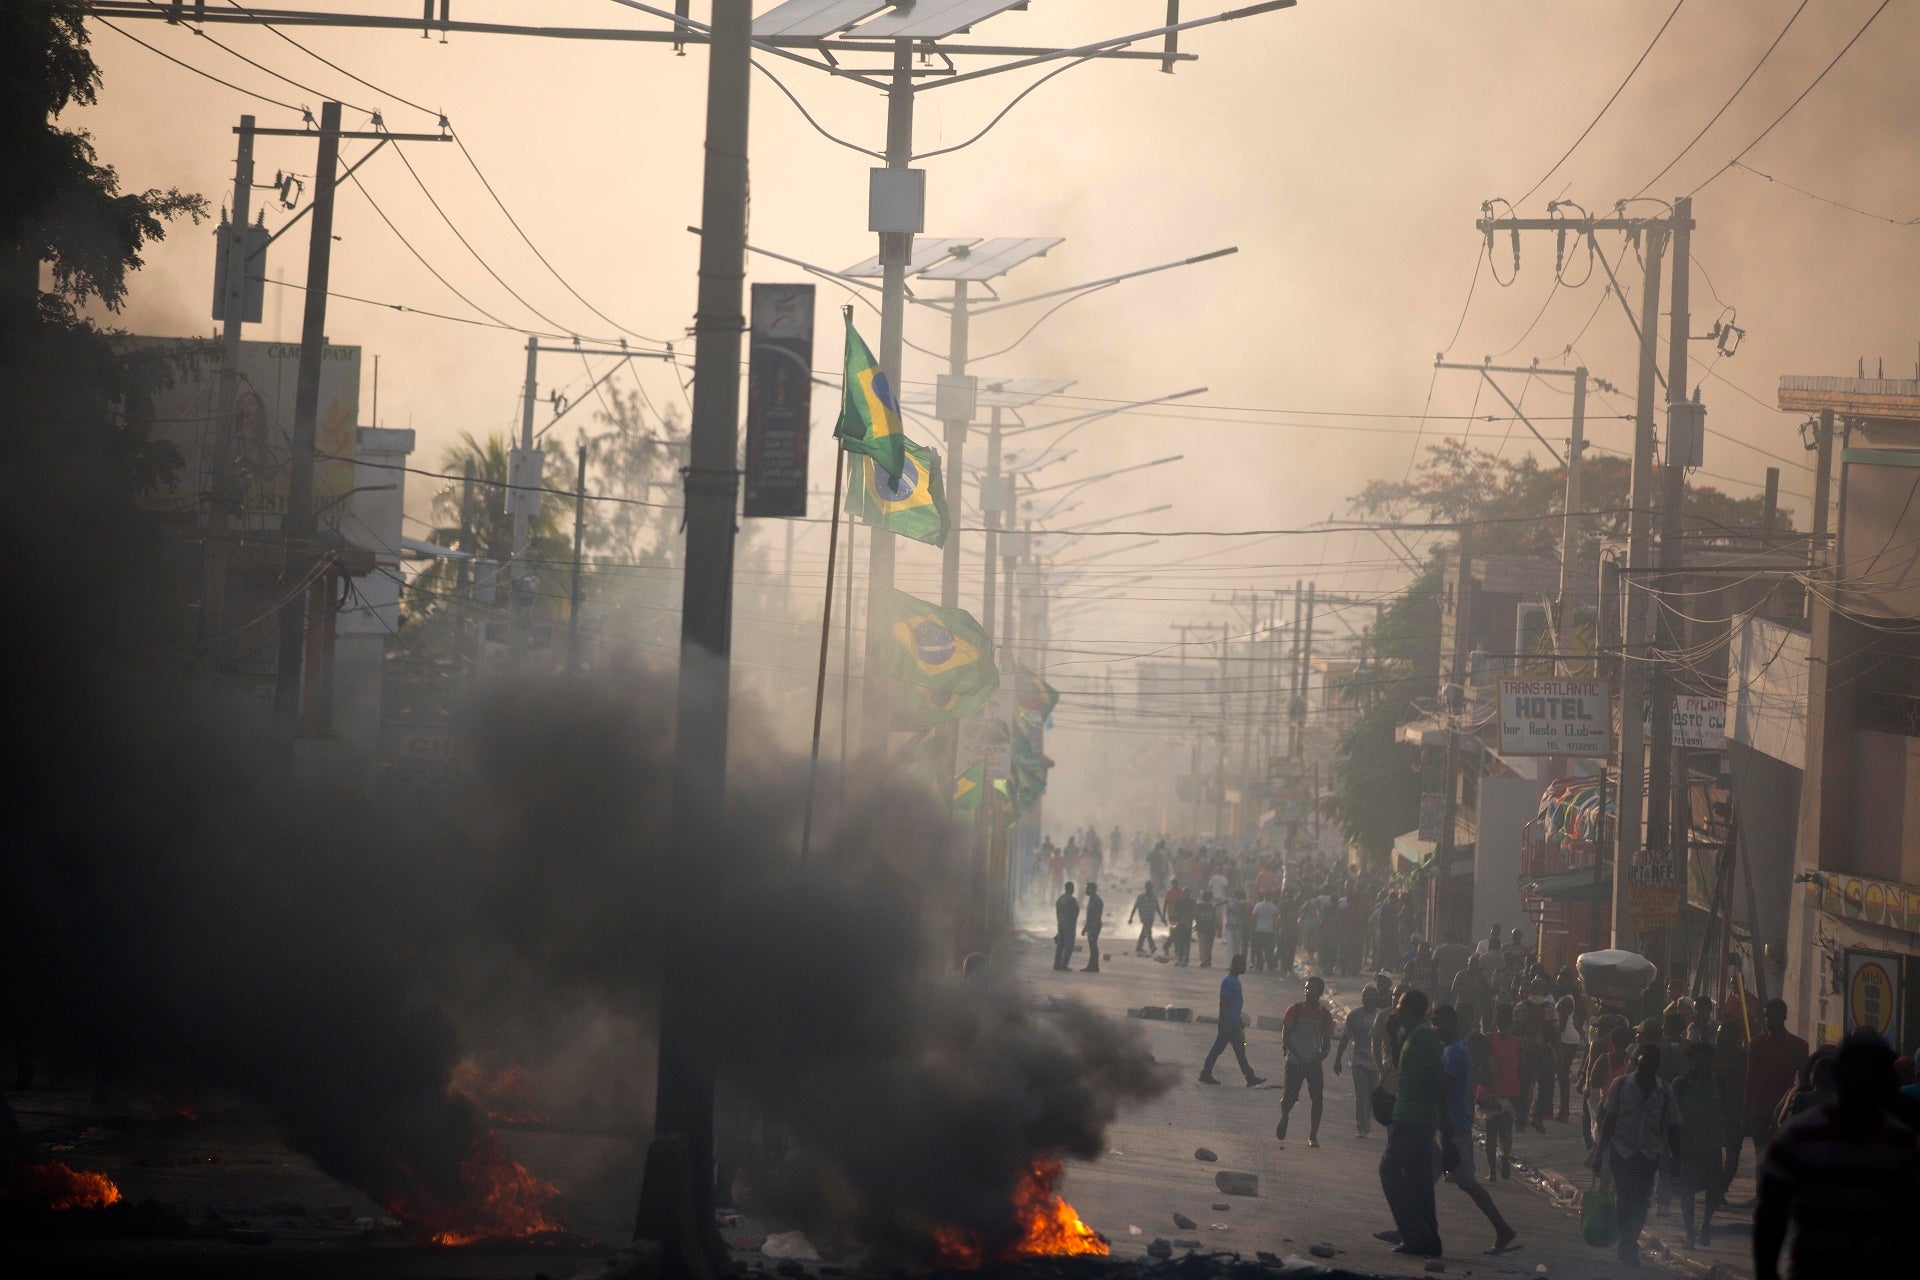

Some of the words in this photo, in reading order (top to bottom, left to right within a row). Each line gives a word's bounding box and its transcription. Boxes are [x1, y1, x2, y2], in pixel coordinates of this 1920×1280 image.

[1503, 681, 1600, 696] TRANS-ATLANTIC
[1516, 697, 1592, 720] HOTEL
[1529, 722, 1557, 736] Resto
